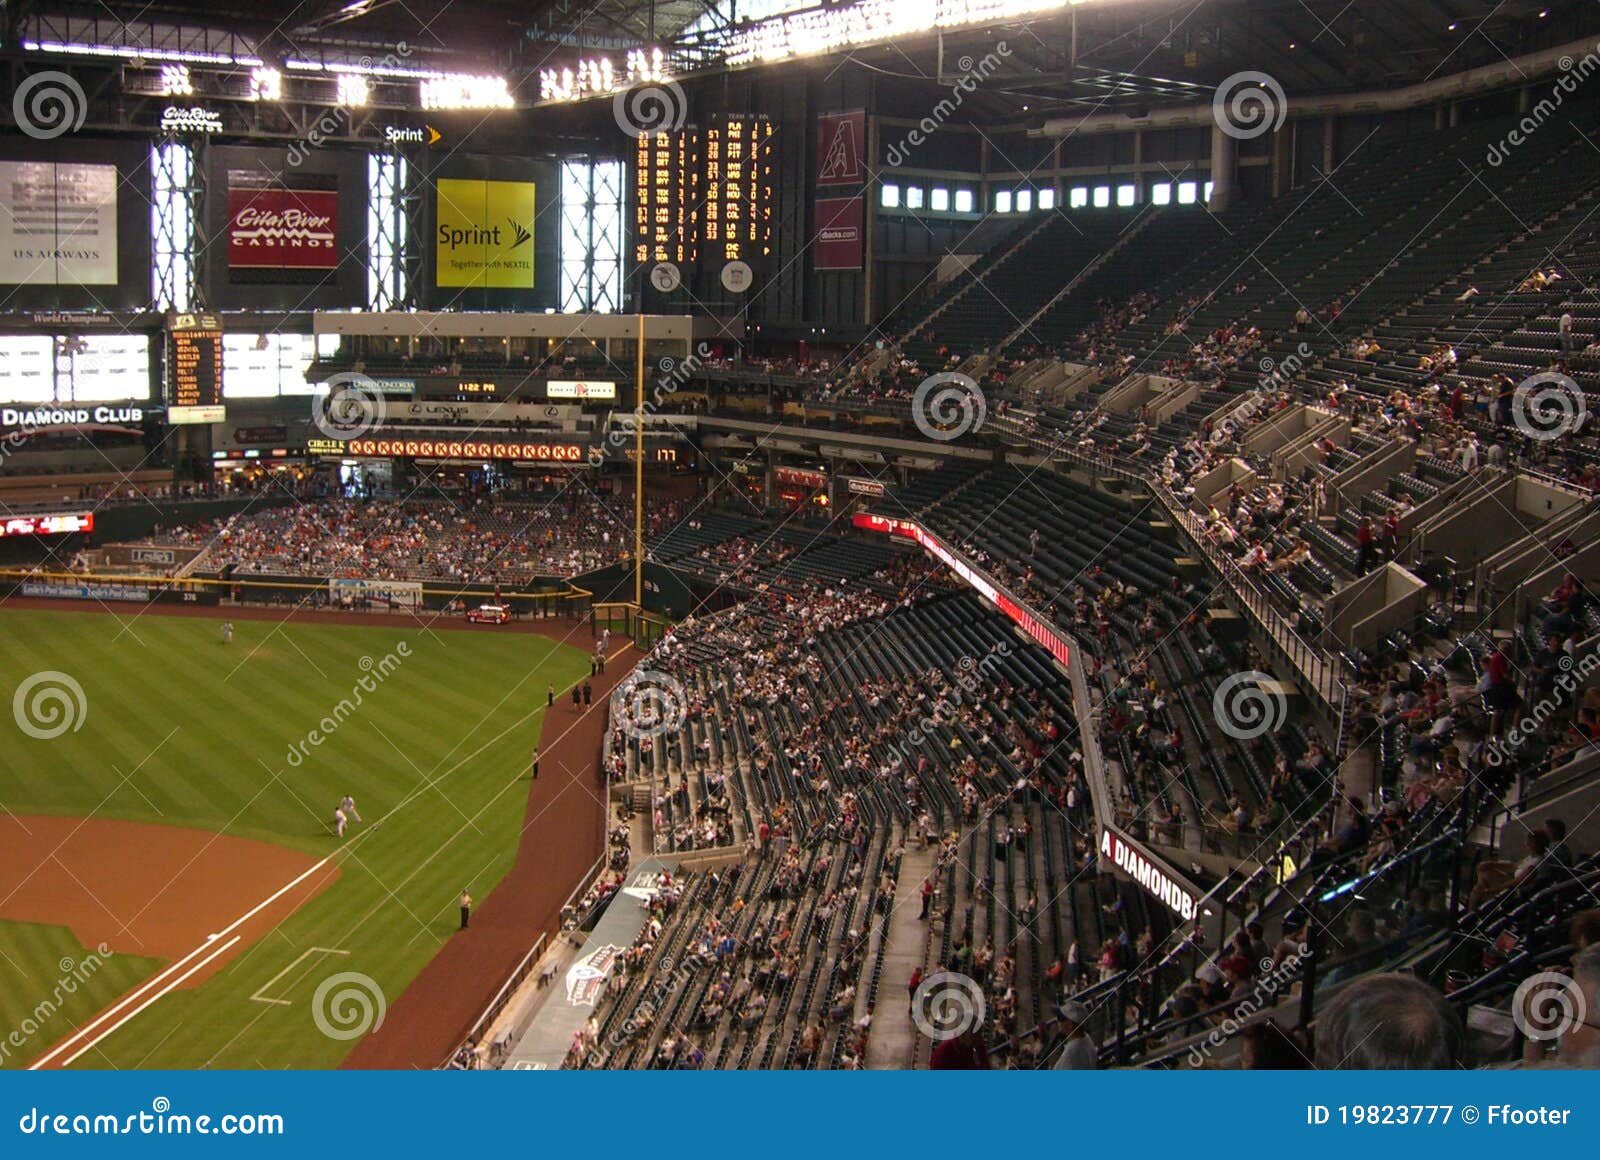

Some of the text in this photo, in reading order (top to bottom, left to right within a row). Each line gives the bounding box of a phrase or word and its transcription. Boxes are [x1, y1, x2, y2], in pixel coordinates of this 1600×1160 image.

[385, 126, 424, 144] Sprint
[237, 208, 330, 228] Gila River
[439, 224, 501, 250] Sprint
[232, 238, 334, 248] CASINOS
[13, 250, 100, 259] US AIRWAYS
[503, 261, 530, 270] NEXTEL
[460, 383, 480, 392] 1:22
[426, 406, 468, 414] LEXUS
[2, 406, 143, 426] DIAMOND CLUB
[308, 440, 336, 448] CIRCLE
[658, 449, 676, 461] 177
[1102, 830, 1198, 920] A DIAMONDB
